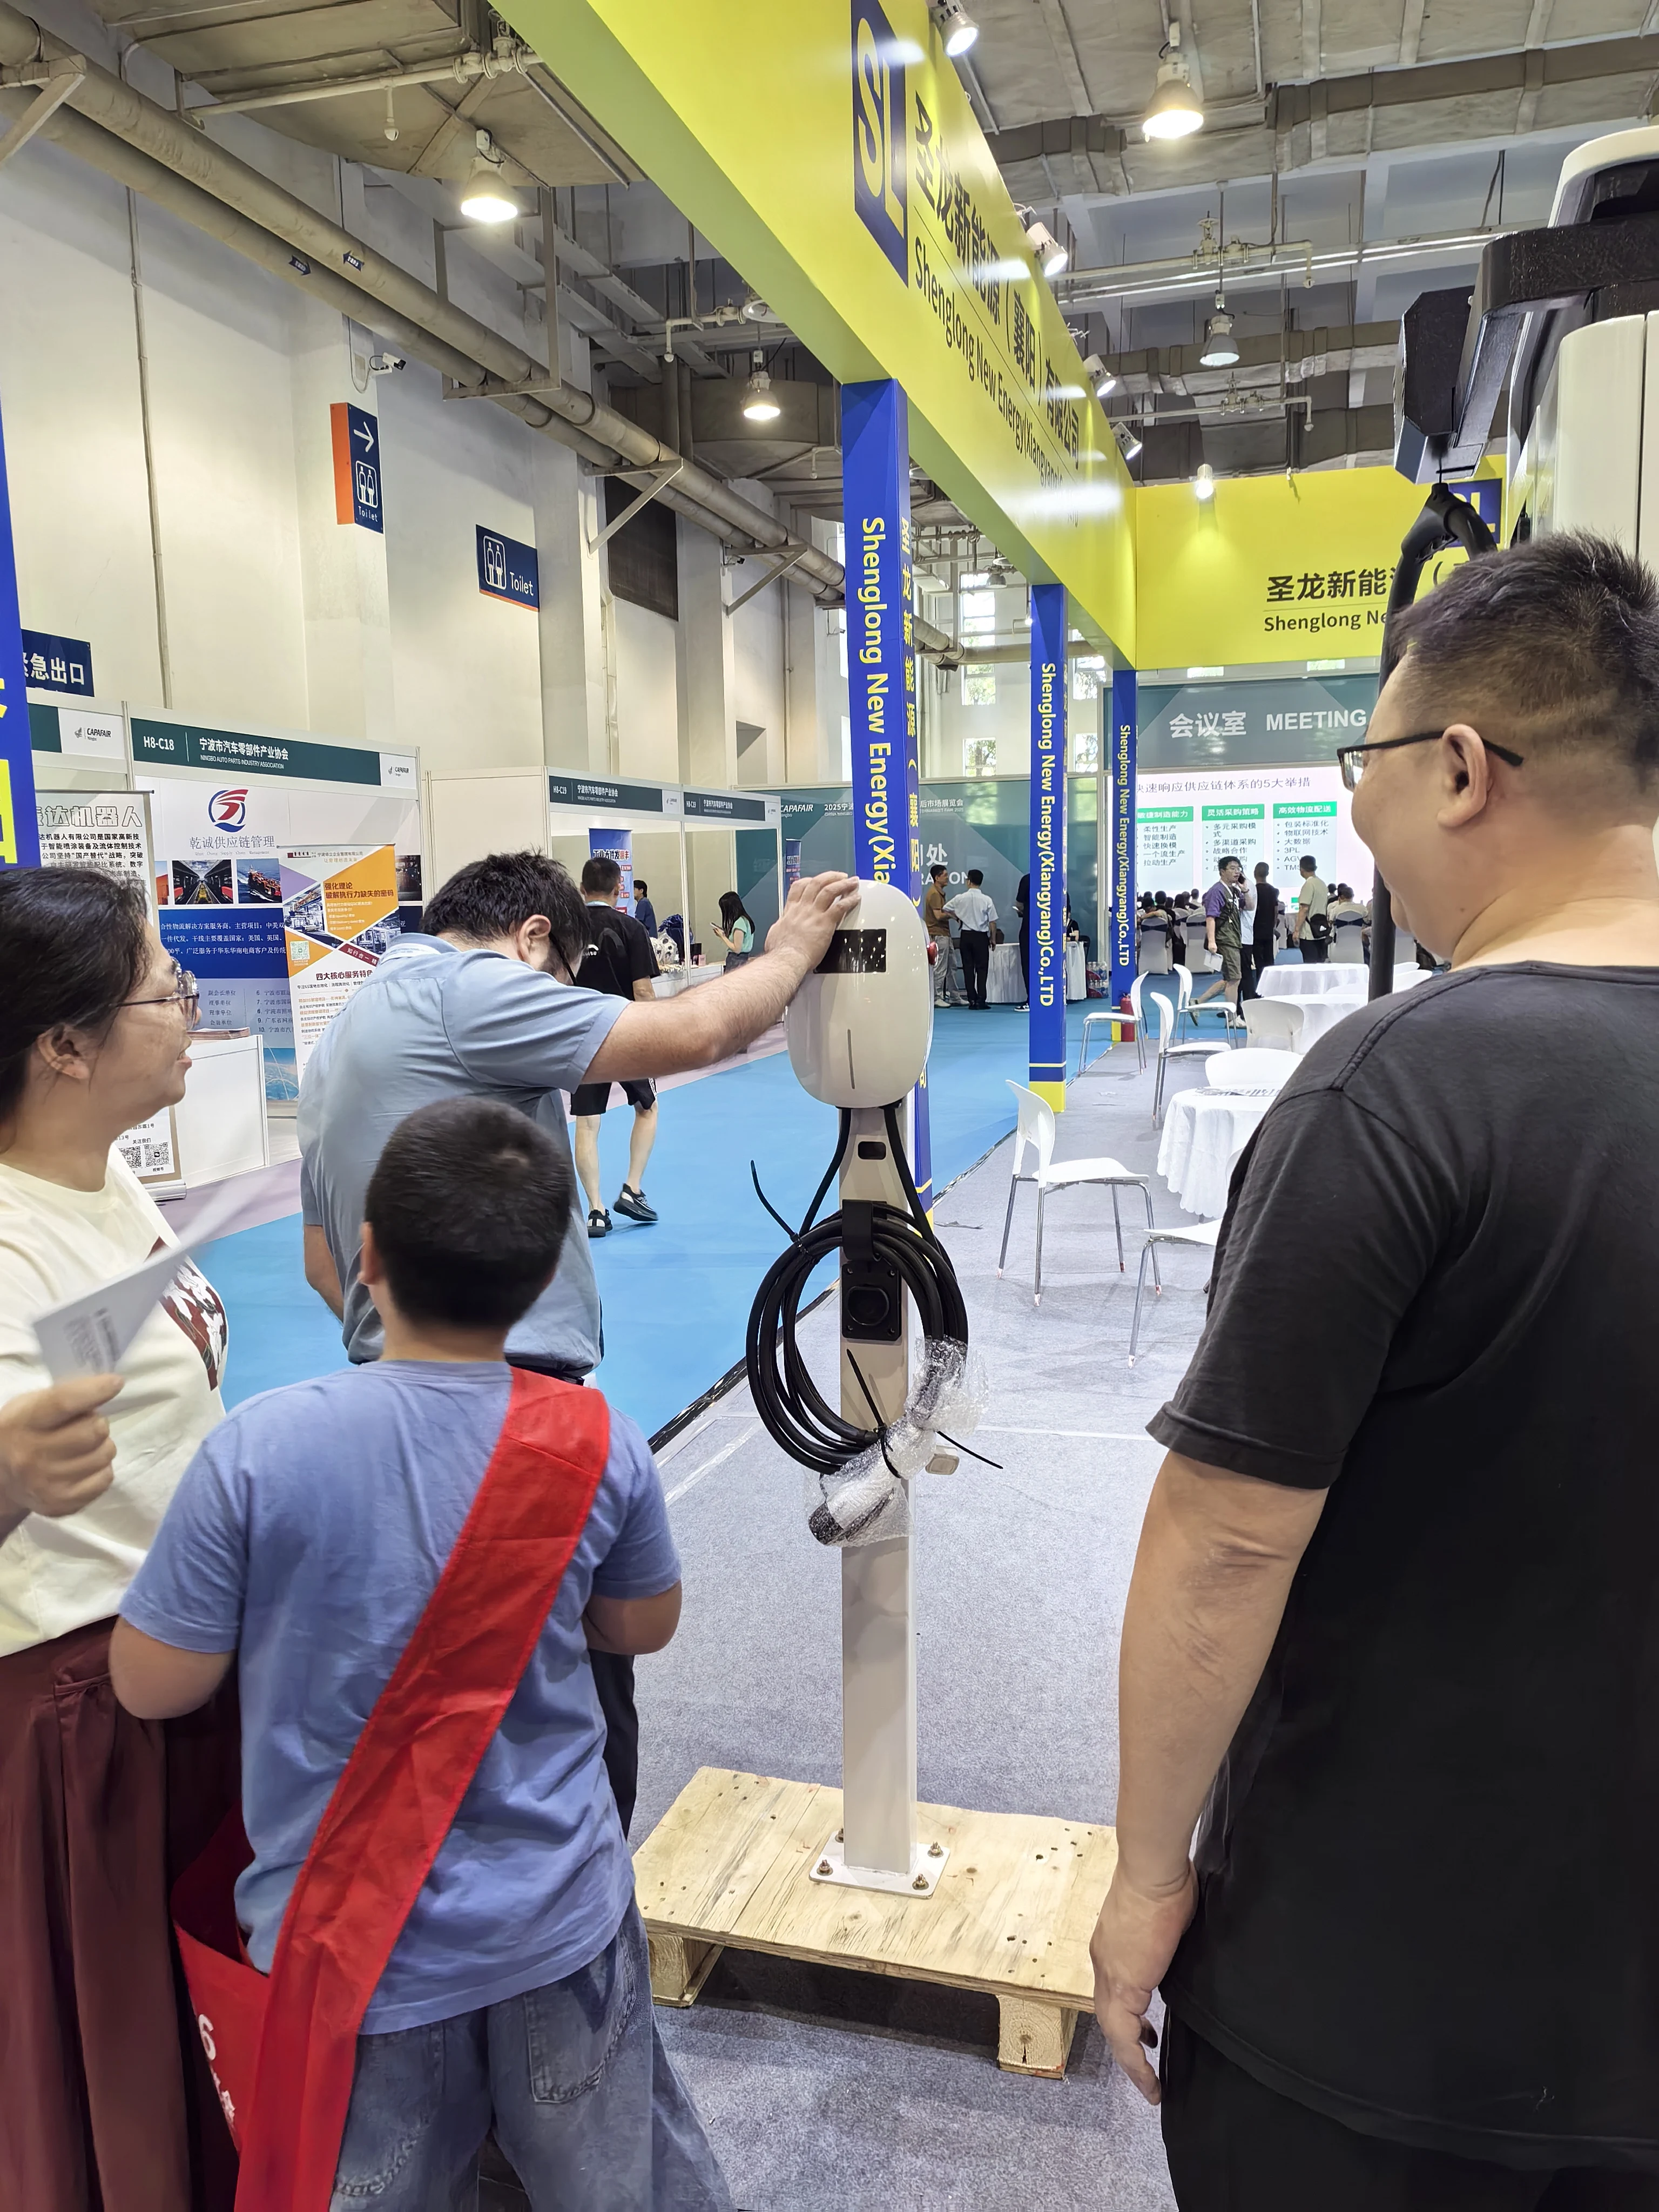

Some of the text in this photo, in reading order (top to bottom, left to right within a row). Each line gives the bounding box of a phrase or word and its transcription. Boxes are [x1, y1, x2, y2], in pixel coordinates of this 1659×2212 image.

[914, 235, 974, 382] Shenglong
[976, 338, 996, 402] New
[358, 505, 378, 522] Toilet
[509, 571, 534, 596] Toilet
[857, 517, 888, 664] Shenglong
[1264, 611, 1361, 633] Shenglong
[866, 673, 889, 734] New
[1168, 710, 1247, 739] 会议室
[1265, 709, 1367, 731] MEETING
[87, 727, 111, 738] CAPAFAIR
[143, 736, 175, 751] H8-C18
[199, 737, 289, 760] 宁波市汽车零部件产业协会
[1117, 724, 1131, 786] Shenglong
[919, 799, 964, 808] 后市场展览会
[1119, 788, 1130, 814] New
[1278, 805, 1332, 814] 高效物流配送
[1143, 825, 1177, 833] 柔性生产
[1284, 820, 1329, 828] 包装标准化
[1036, 663, 1057, 1007] Shenglong New Energy(Xiangyang)Co.,LTD
[1143, 833, 1177, 841] 智能制造
[1284, 828, 1329, 837] 物联网技术
[189, 835, 275, 849] 乾诚供应链管理
[1284, 838, 1311, 846] 大数据
[325, 882, 353, 890] 强化理论
[326, 889, 394, 899] 破解执行力缺失的密码
